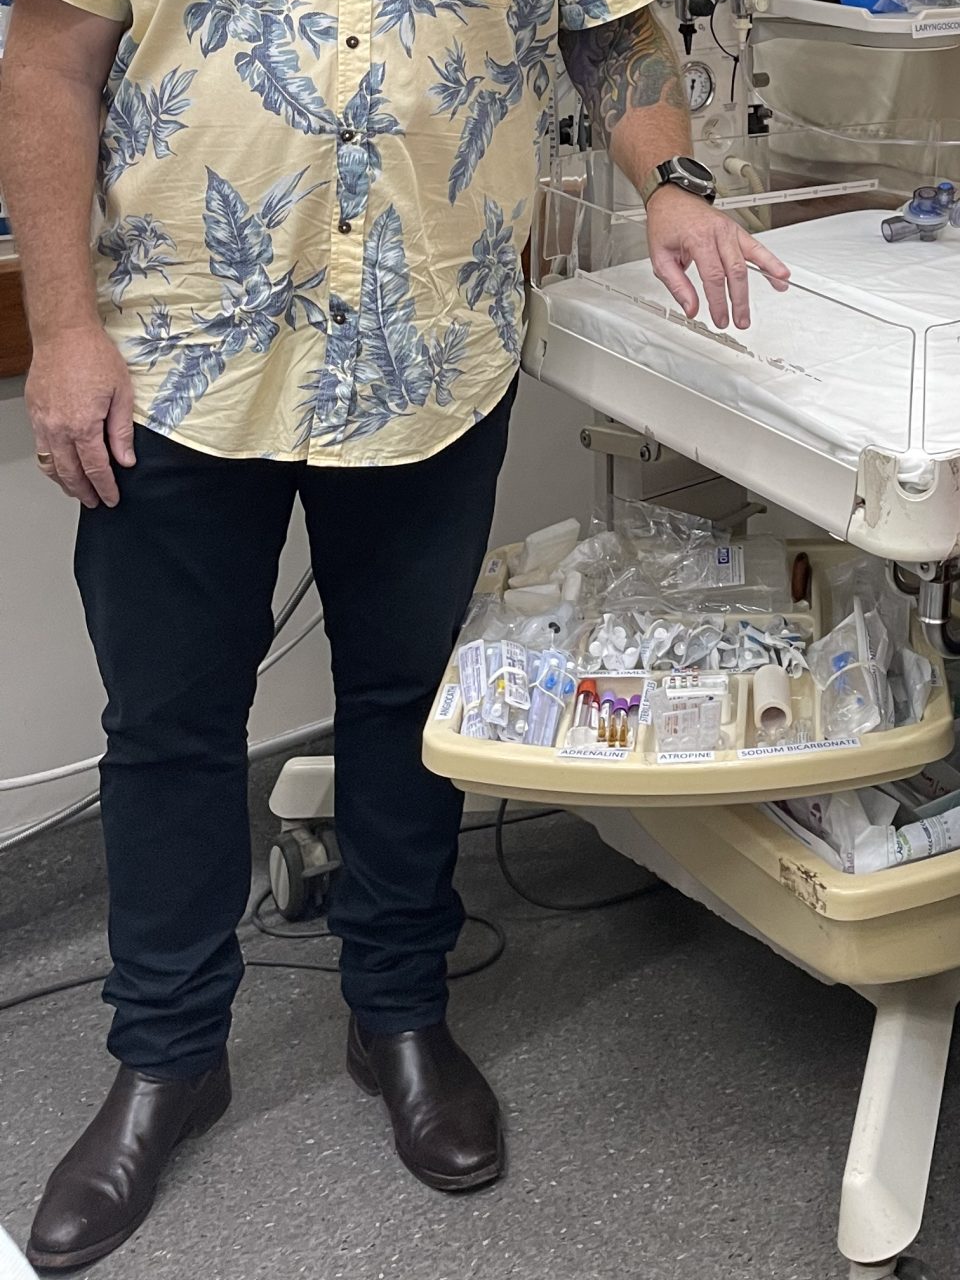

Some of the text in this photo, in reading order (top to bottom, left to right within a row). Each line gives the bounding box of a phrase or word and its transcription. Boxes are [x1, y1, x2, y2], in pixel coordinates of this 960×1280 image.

[741, 738, 858, 757] SODIUM BICARBONATE
[560, 748, 627, 759] ADRENALINE
[659, 751, 712, 760] ATROPINE
